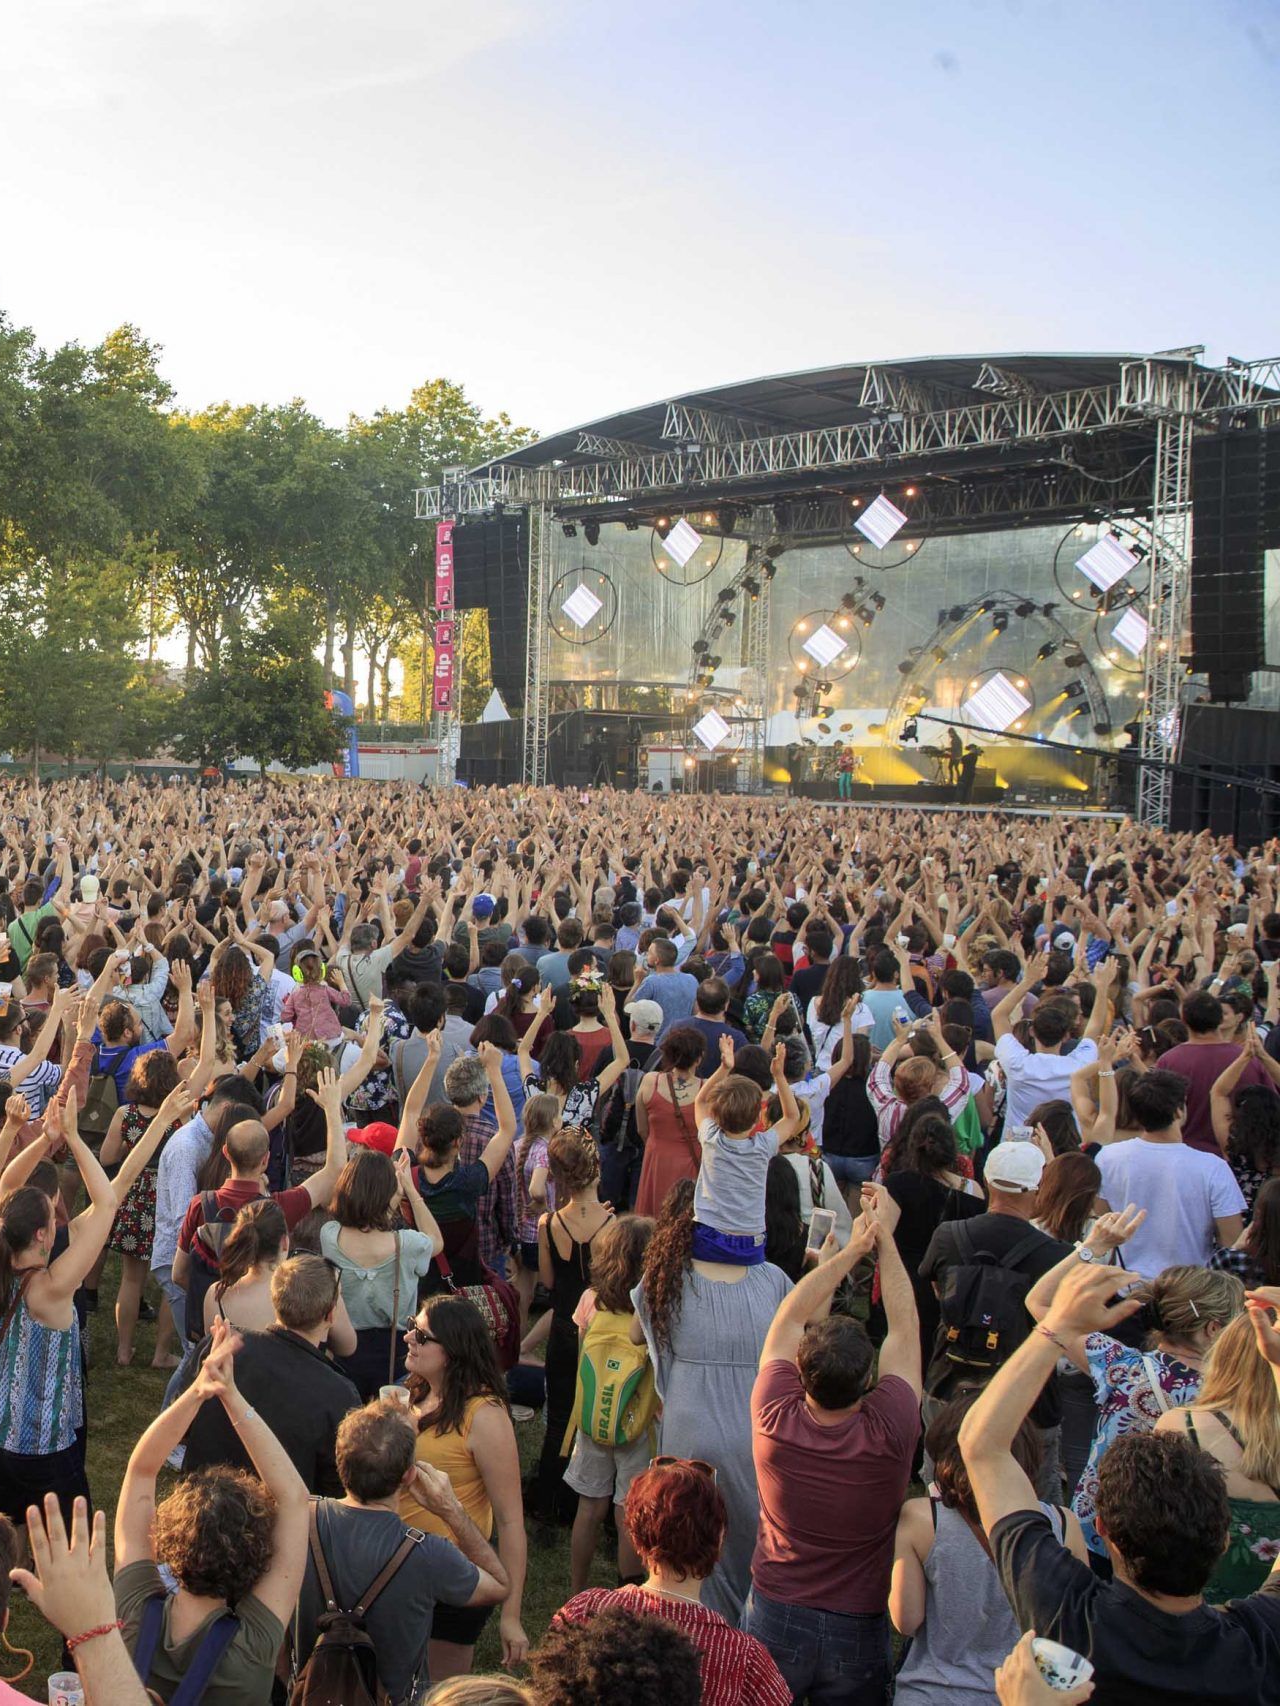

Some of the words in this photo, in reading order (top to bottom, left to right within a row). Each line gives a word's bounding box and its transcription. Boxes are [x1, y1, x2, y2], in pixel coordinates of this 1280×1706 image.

[437, 553, 452, 578] fip
[436, 653, 452, 678] fip
[598, 1383, 616, 1440] BRASIL
